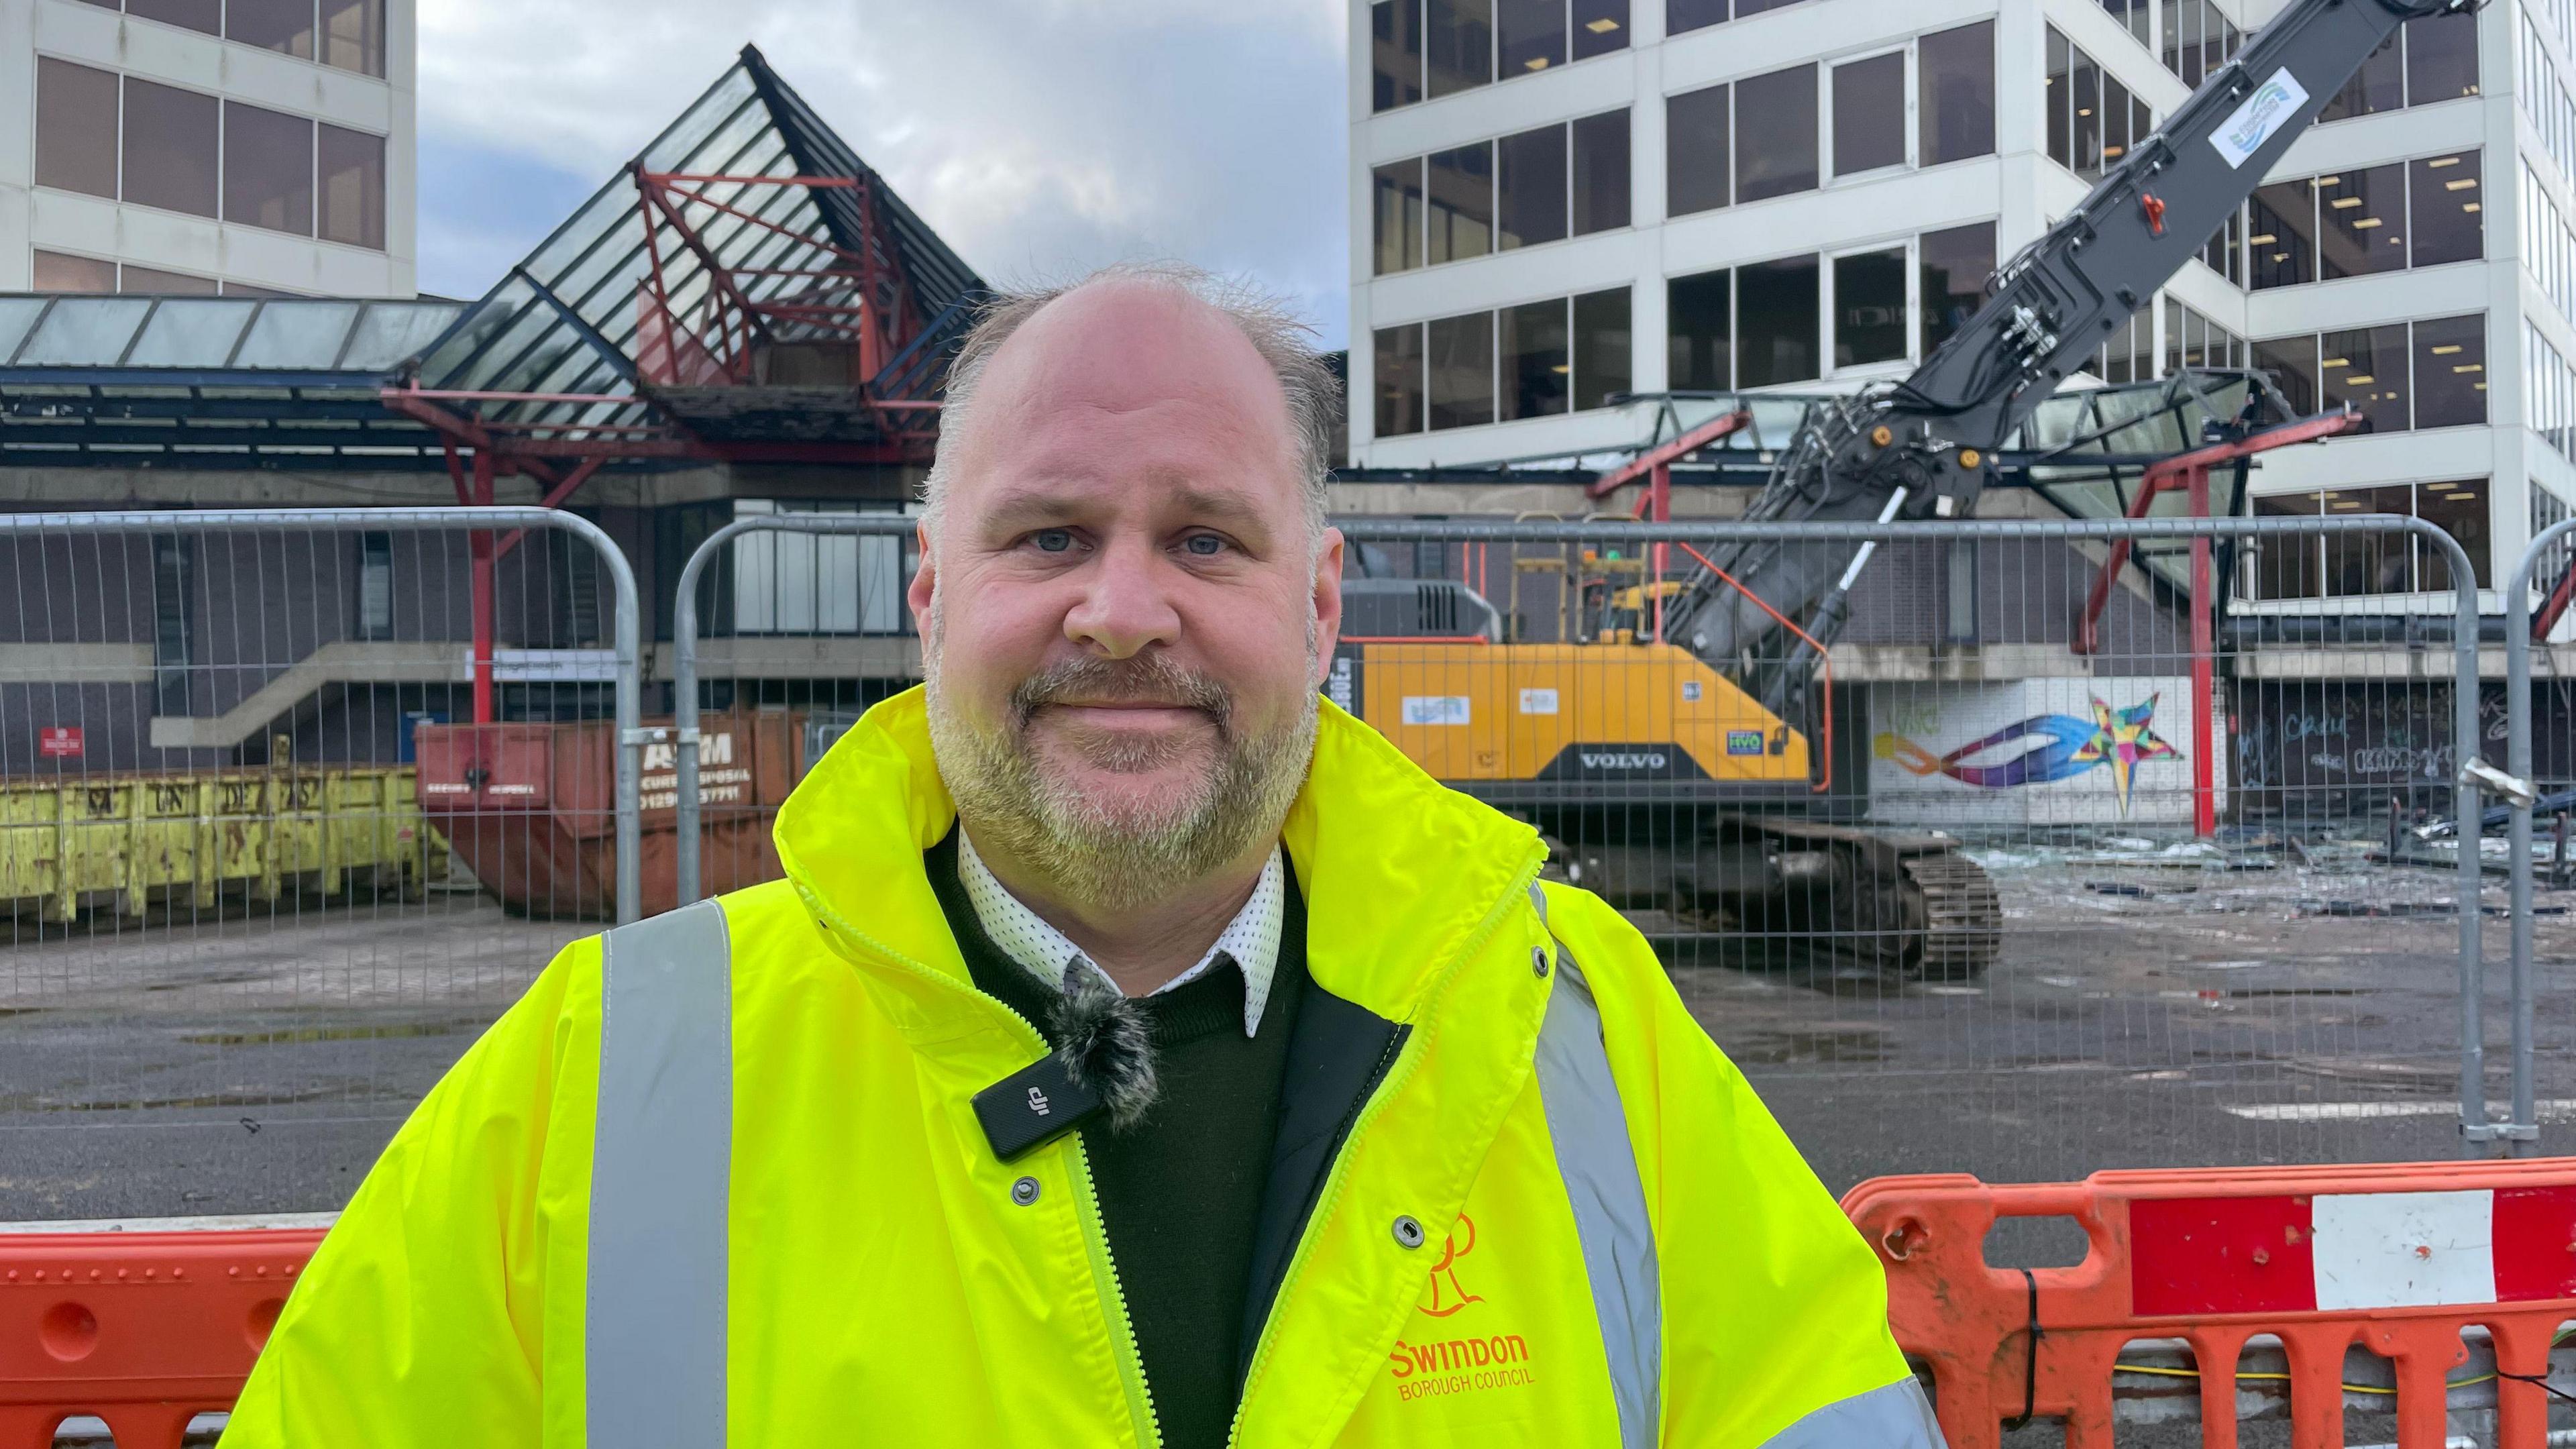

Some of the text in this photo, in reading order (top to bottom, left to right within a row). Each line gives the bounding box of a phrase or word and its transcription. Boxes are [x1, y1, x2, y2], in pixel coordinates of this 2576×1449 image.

[644, 733, 731, 769] AM
[1579, 753, 1665, 769] VOLVO
[1397, 1368, 1536, 1401] BOROUGH COUNCIL
